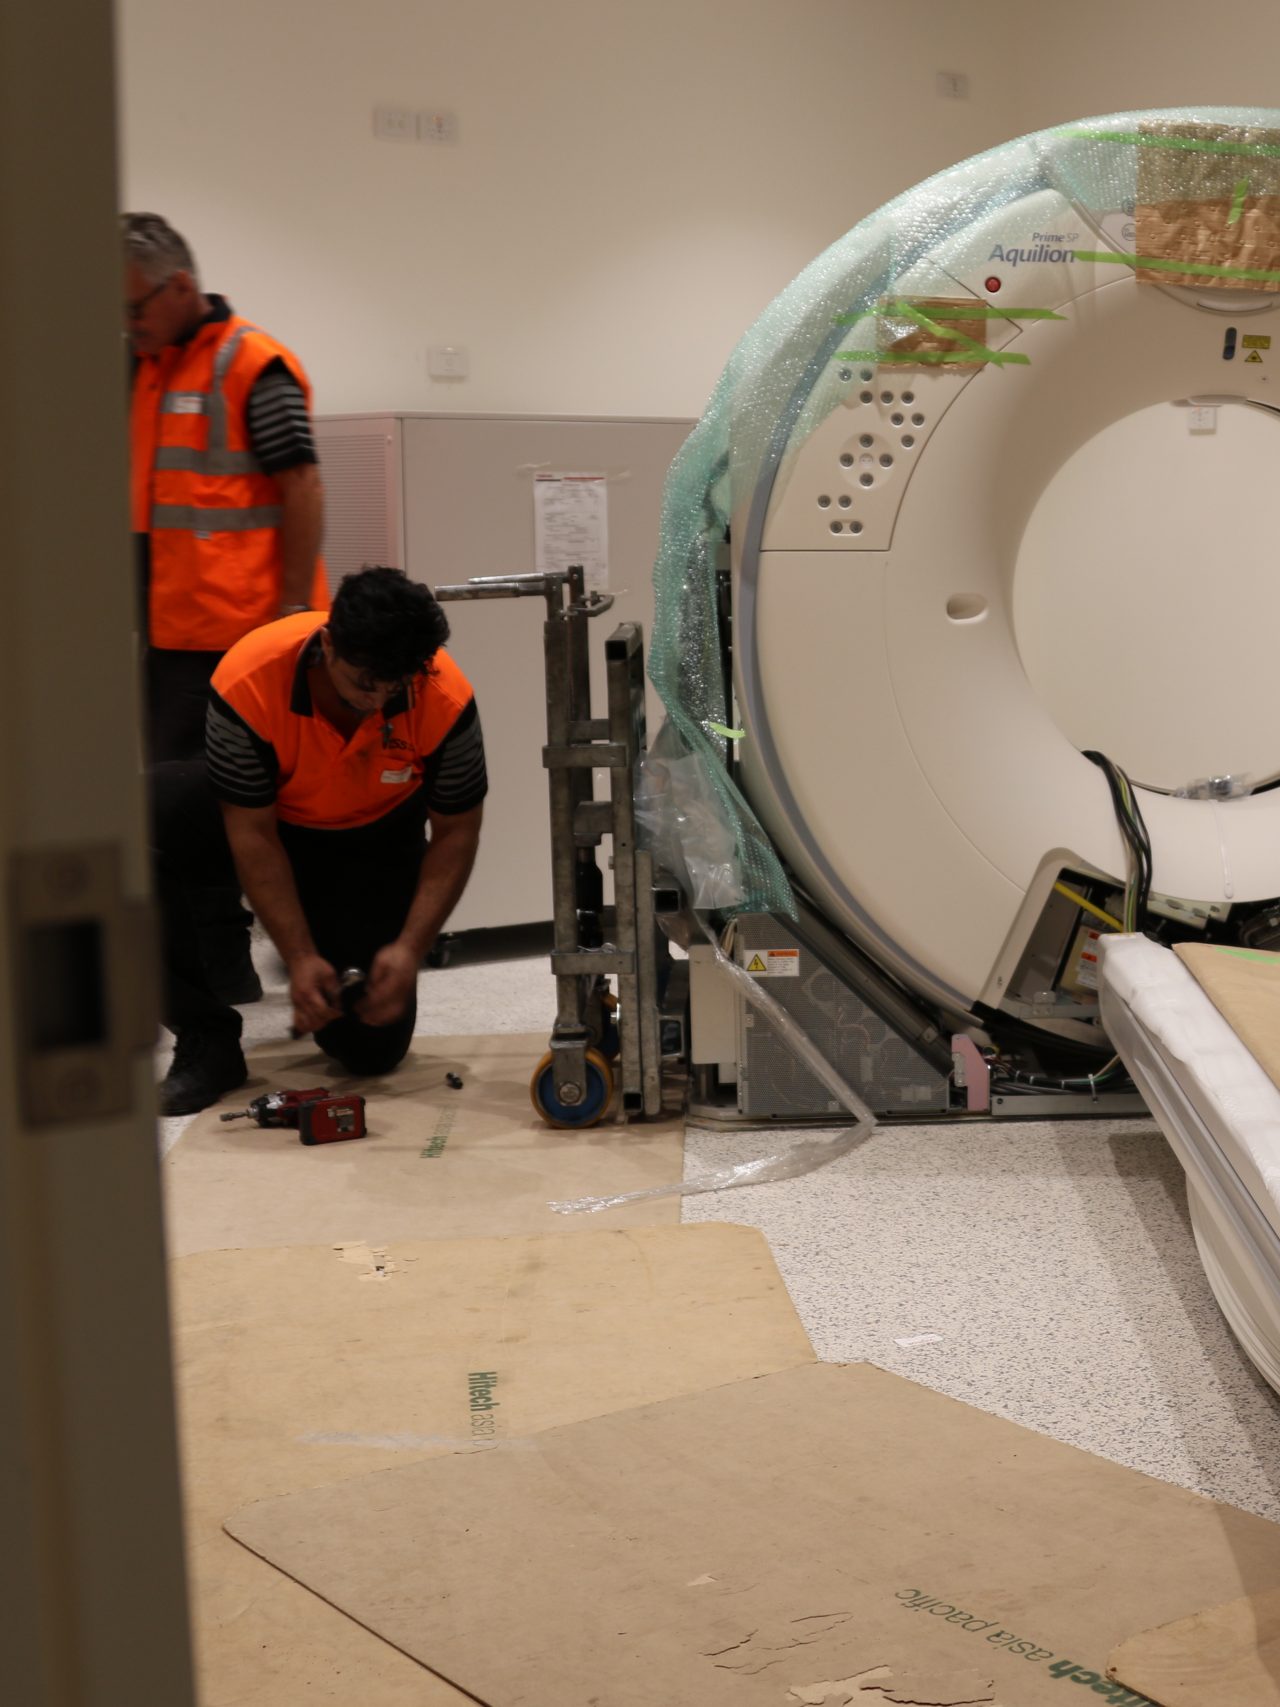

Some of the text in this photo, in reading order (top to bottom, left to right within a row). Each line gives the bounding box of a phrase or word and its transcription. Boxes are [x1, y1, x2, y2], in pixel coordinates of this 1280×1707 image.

[1032, 232, 1080, 243] Prime SP
[988, 244, 1075, 267] Aquilion
[468, 1372, 500, 1411] Hitech
[471, 1413, 496, 1436] asia
[894, 1588, 1152, 1707] itech asia pacific
